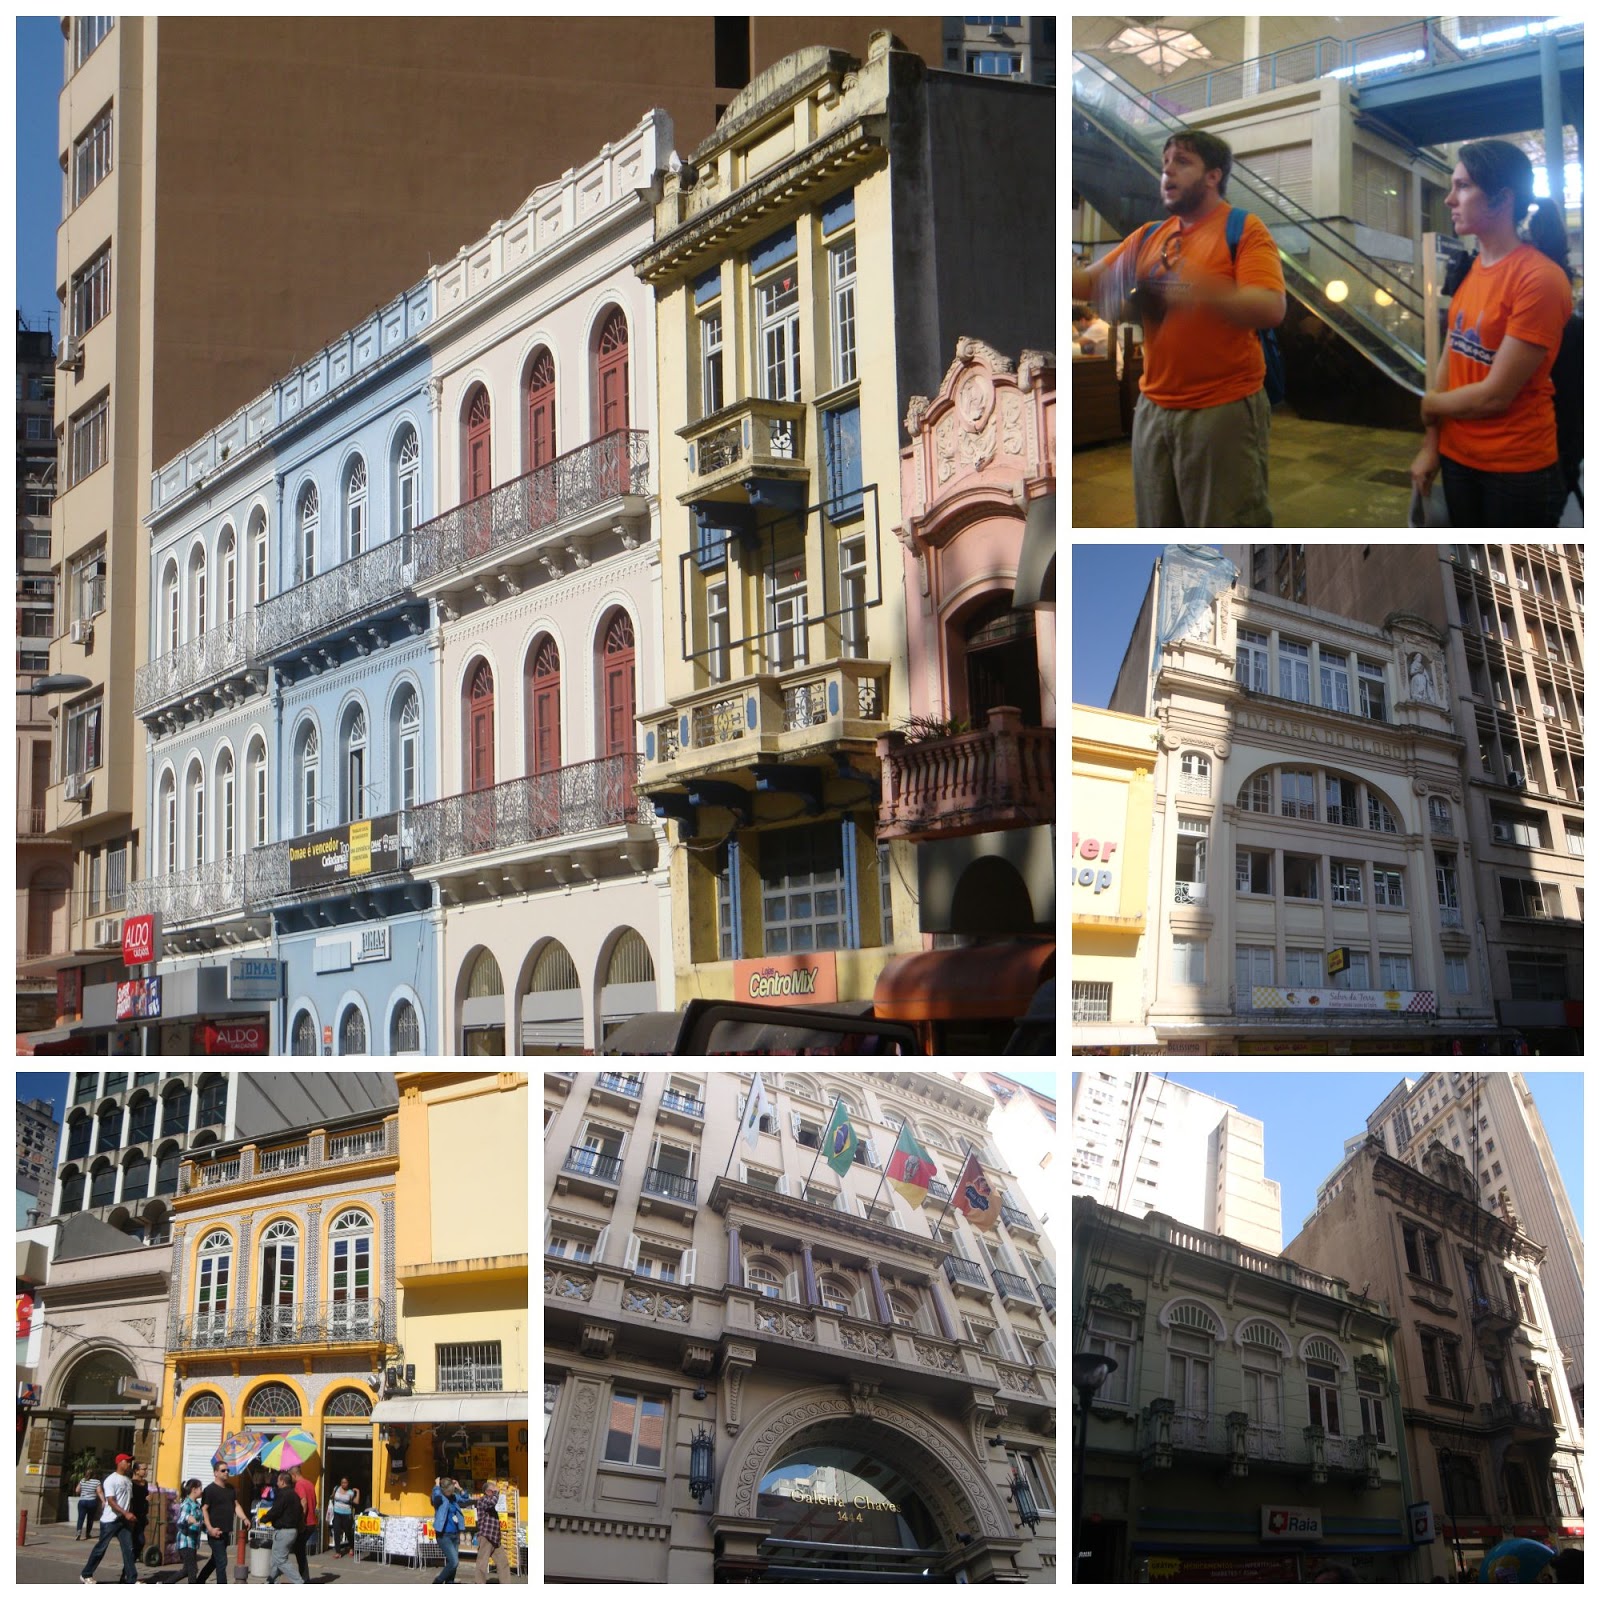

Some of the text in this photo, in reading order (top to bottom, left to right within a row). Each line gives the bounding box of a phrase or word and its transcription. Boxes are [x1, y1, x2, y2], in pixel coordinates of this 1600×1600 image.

[1236, 710, 1401, 759] LIVRARIA DO GLOBO
[290, 847, 306, 861] Dmae
[312, 837, 339, 856] vencedor
[125, 922, 149, 948] ALDO
[245, 961, 276, 975] DMAE
[217, 1029, 259, 1044] ALDO
[791, 1489, 901, 1513] Galeria Chaves
[837, 1510, 863, 1523] 1444
[1289, 1517, 1318, 1531] Raia
